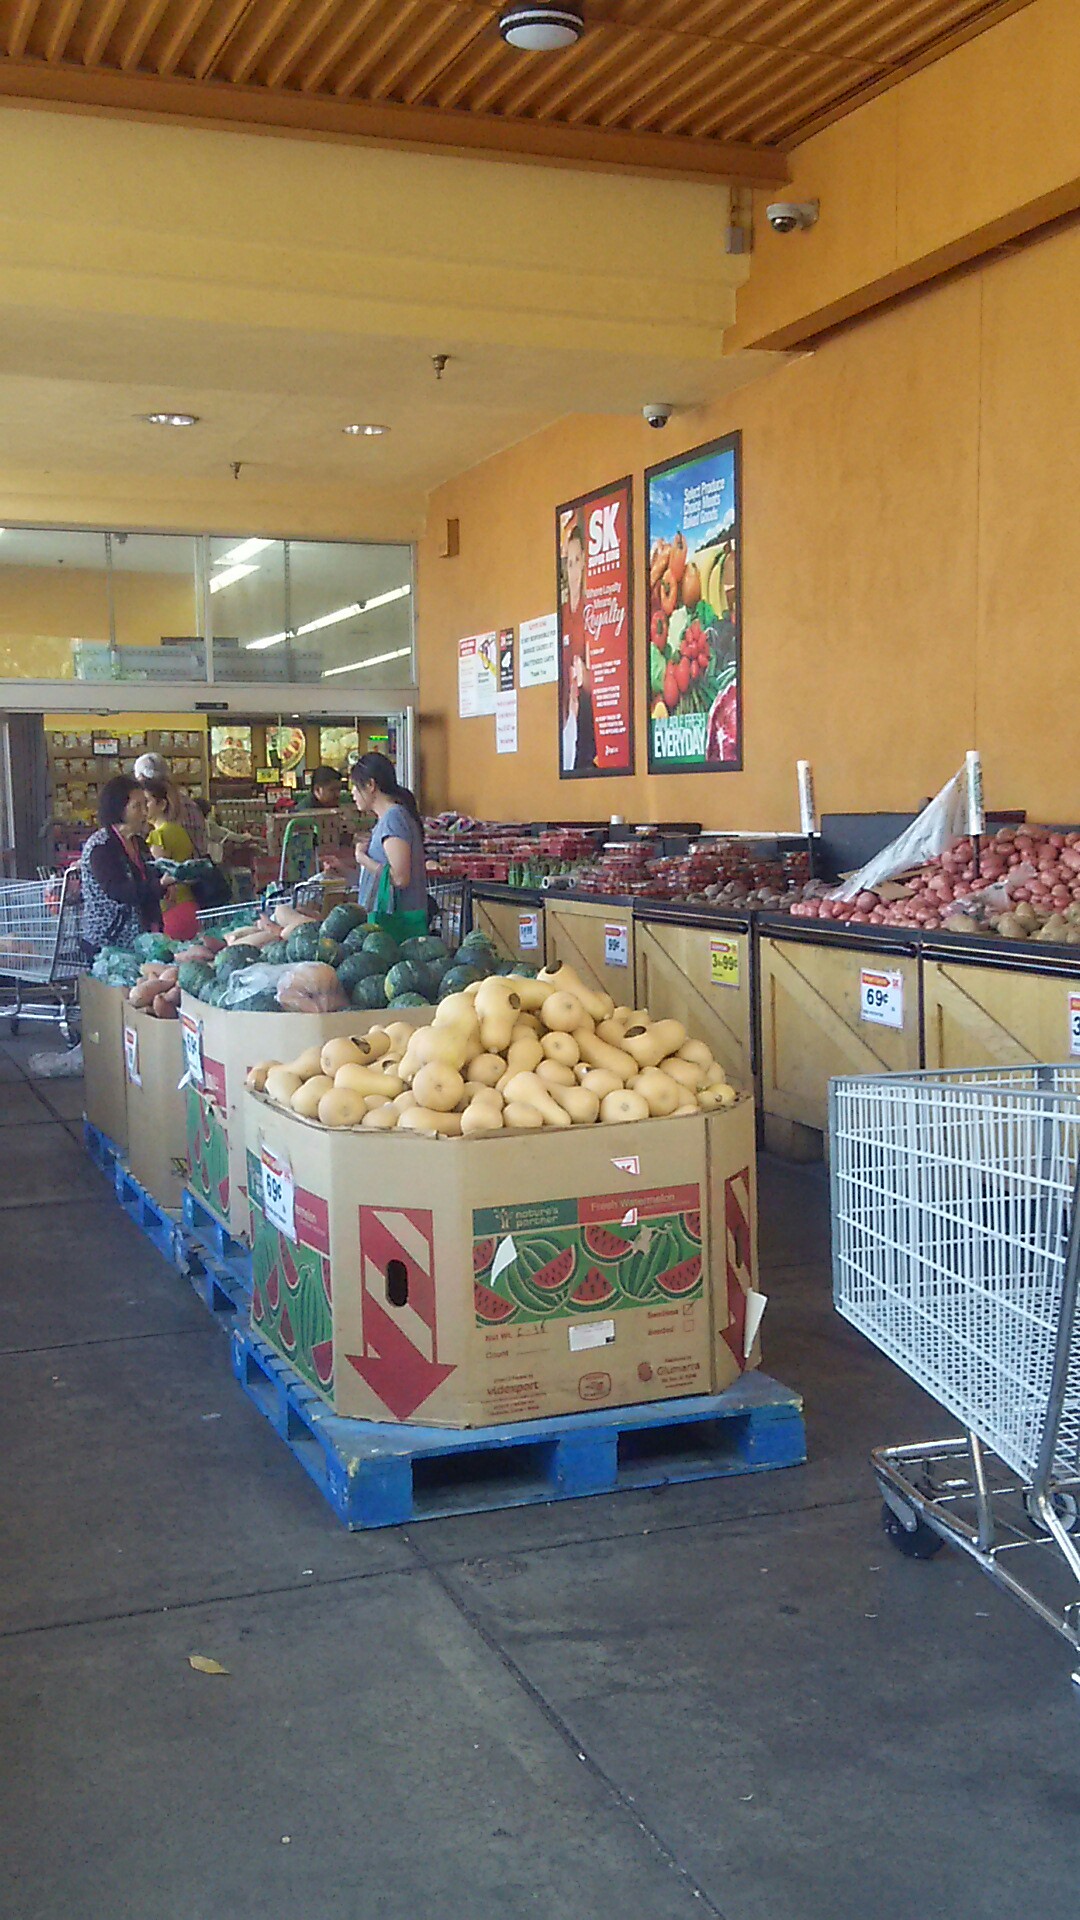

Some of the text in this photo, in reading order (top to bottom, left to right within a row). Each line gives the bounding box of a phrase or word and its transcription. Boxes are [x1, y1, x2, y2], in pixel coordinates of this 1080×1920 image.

[588, 502, 620, 556] SK
[584, 598, 625, 642] Royalty
[655, 726, 705, 758] EVERYDAY
[867, 988, 889, 1007] 69¢
[267, 1173, 282, 1202] 69¢
